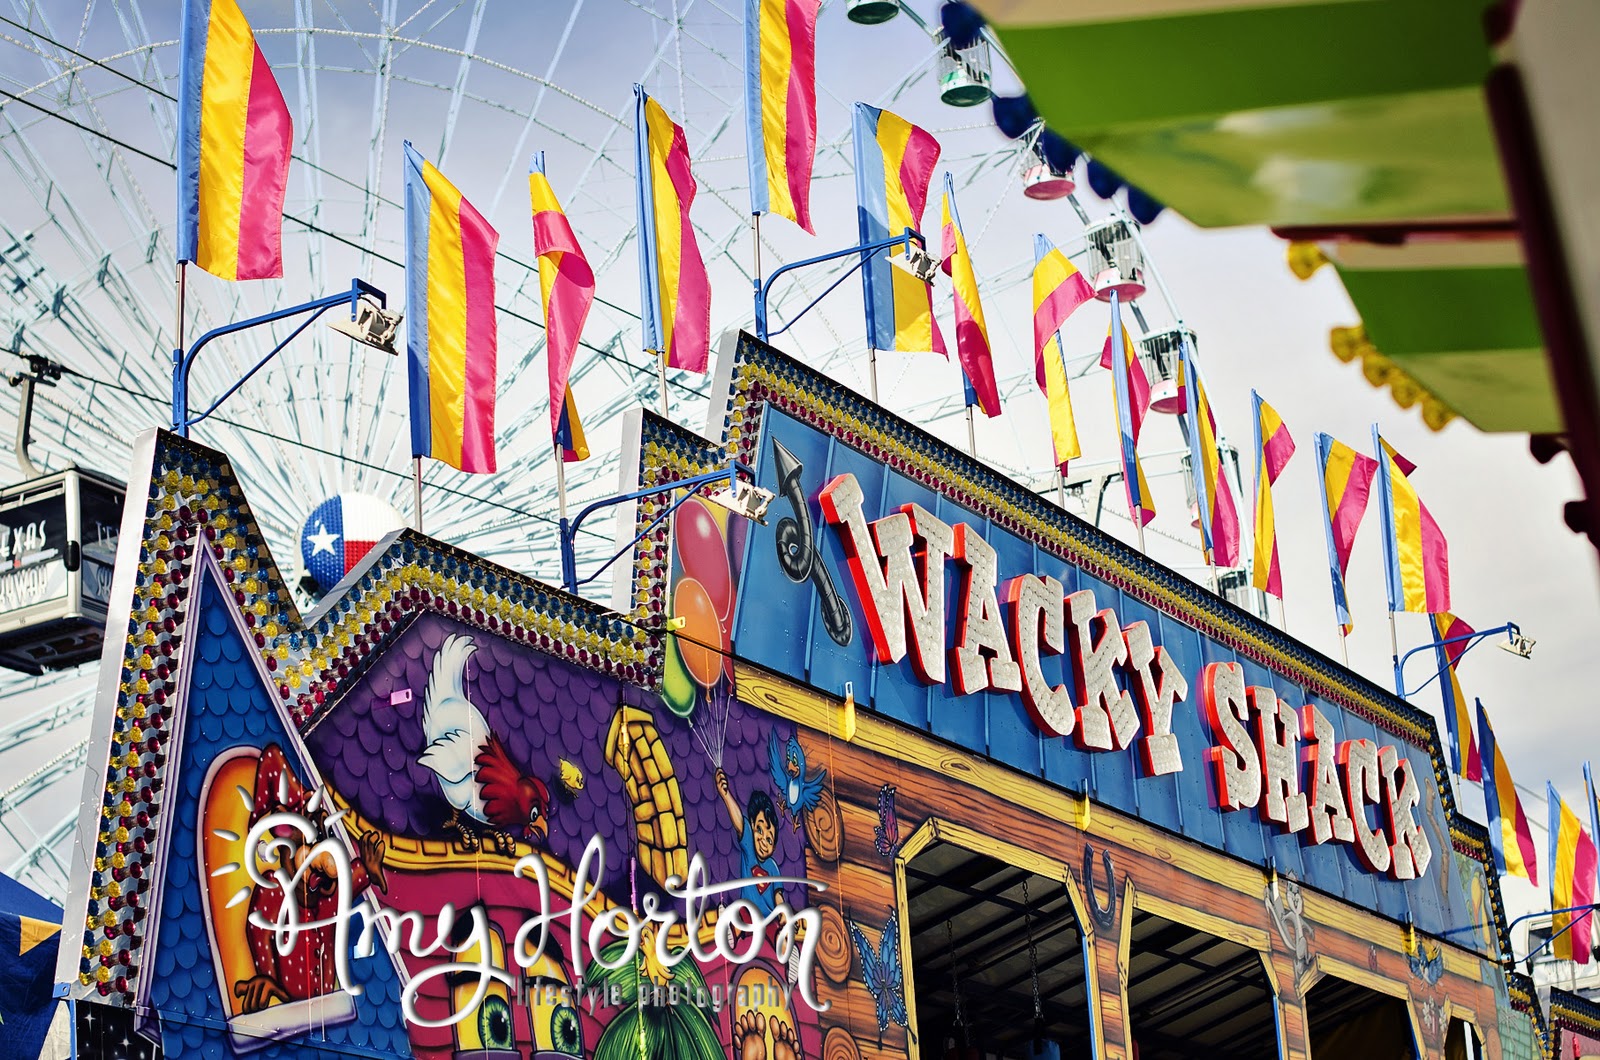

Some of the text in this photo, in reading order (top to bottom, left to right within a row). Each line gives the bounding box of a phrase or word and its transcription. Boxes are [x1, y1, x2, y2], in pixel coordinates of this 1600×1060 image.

[0, 519, 46, 558] EXAS
[0, 563, 47, 606] YWAY
[819, 473, 1433, 881] WACKY SHACK
